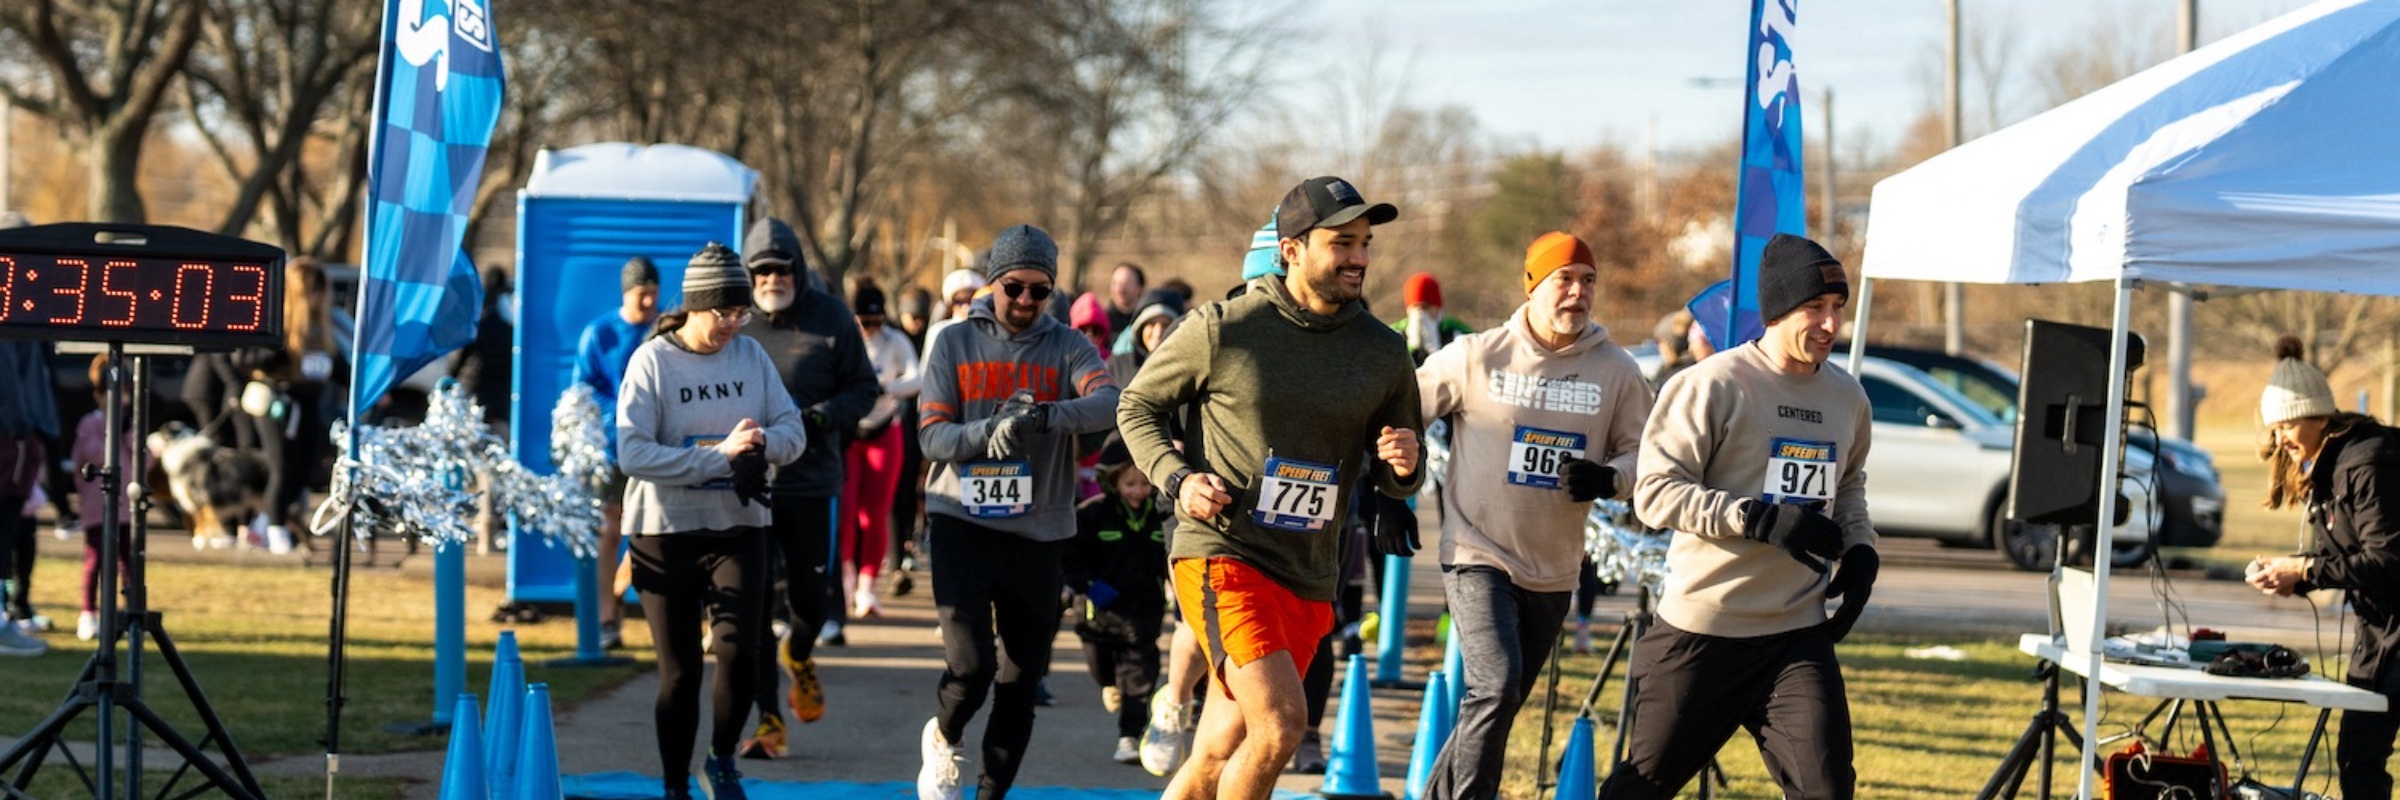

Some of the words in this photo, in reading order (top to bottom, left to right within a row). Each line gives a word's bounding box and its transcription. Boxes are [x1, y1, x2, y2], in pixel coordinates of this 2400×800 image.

[680, 382, 743, 403] DKNY
[957, 361, 1059, 402] BENGALS
[1778, 405, 1823, 424] CENTERED
[972, 479, 1020, 504] 344
[1781, 461, 1827, 496] 971
[1273, 481, 1327, 516] 775
